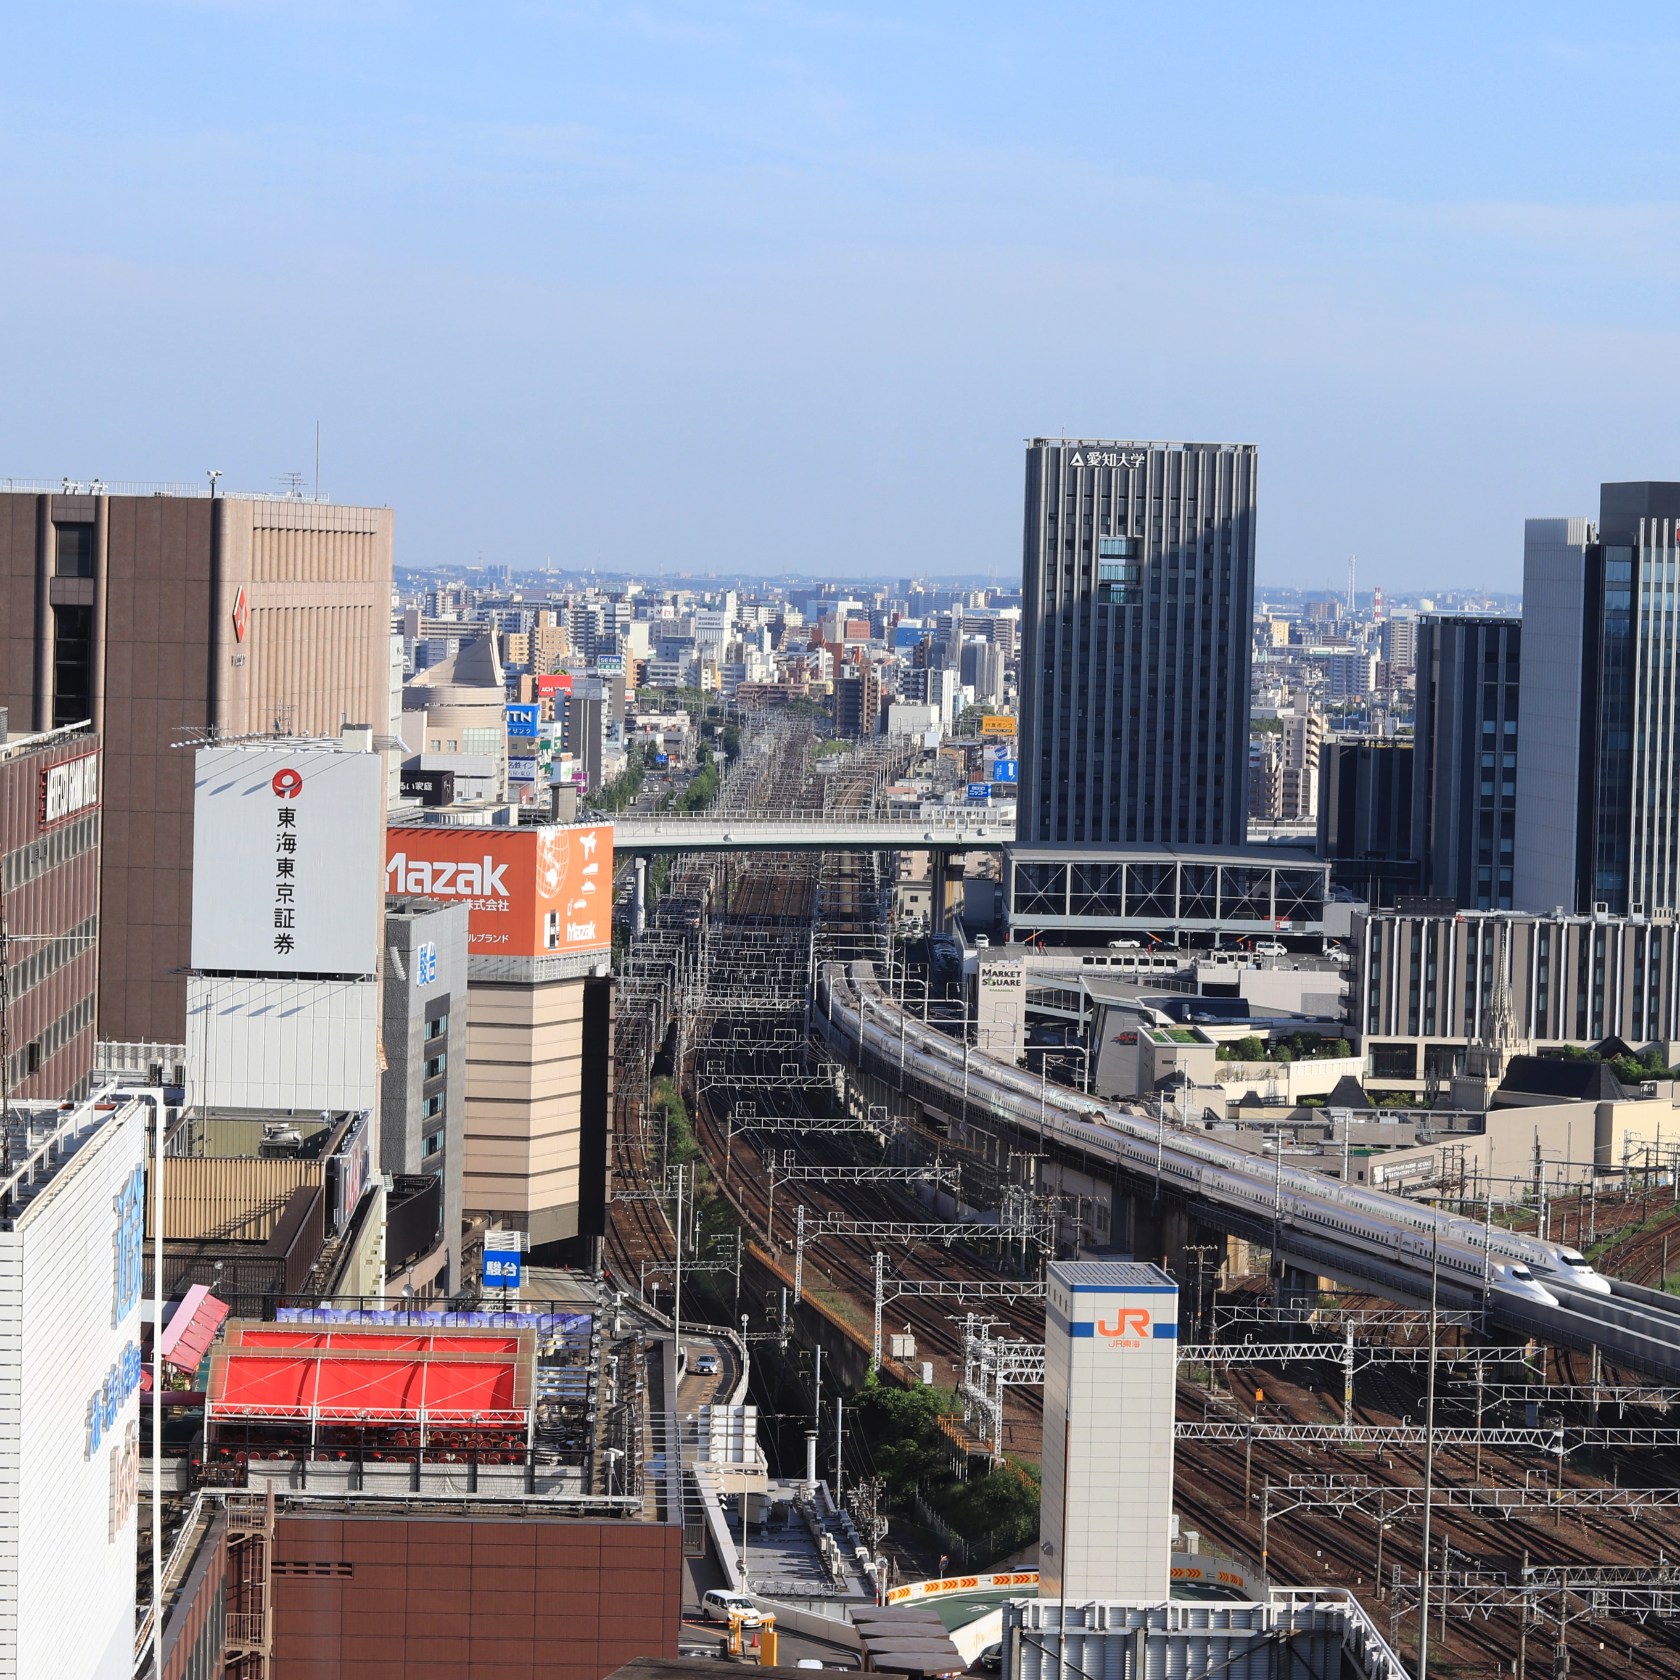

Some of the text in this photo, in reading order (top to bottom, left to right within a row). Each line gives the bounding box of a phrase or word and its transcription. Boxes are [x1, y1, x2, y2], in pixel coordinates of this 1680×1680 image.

[1086, 451, 1145, 468] 愛知大学
[273, 806, 298, 955] 東海東京証券
[567, 920, 596, 942] Mazak
[982, 969, 1022, 978] MARKET
[486, 1261, 518, 1276] 駿台
[1098, 1308, 1151, 1337] JR
[1108, 1339, 1141, 1348] JR東海
